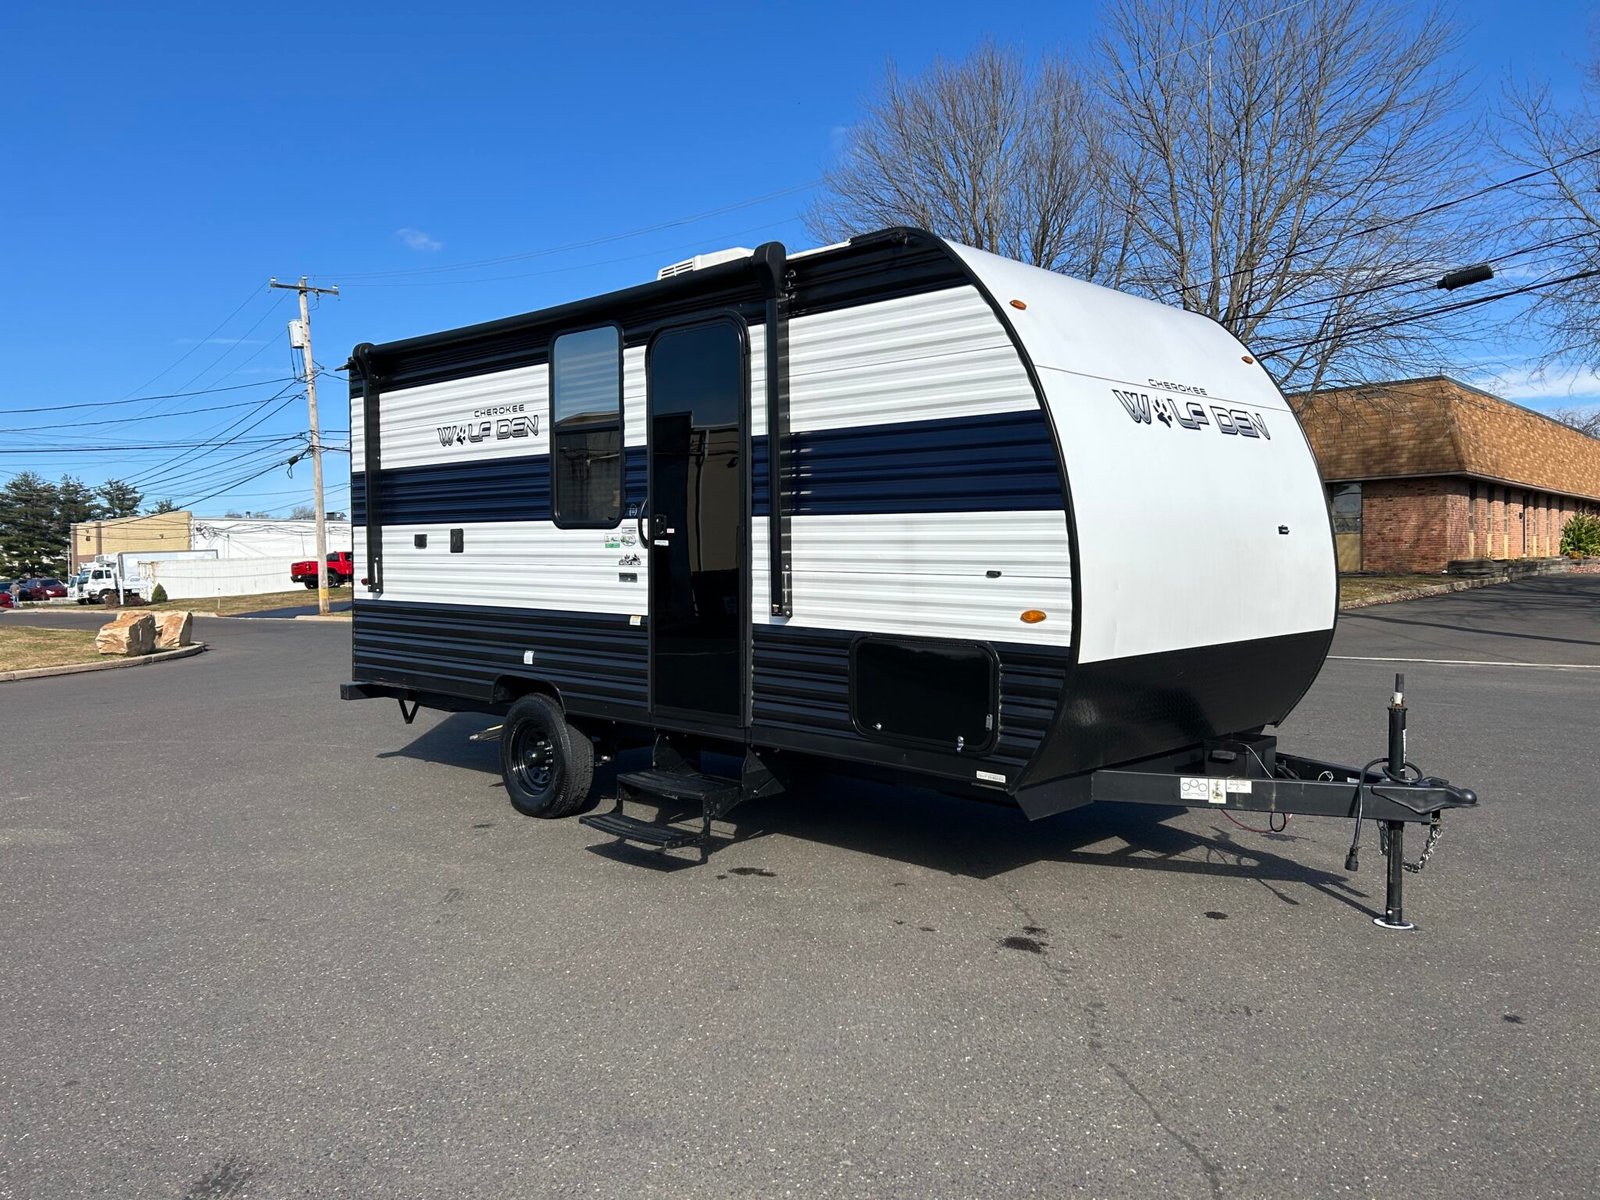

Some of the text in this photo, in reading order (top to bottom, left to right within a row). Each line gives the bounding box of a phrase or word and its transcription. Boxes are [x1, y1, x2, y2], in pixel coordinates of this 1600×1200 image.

[1148, 379, 1208, 395] CHEROKEE
[474, 404, 524, 417] CHEROKEE
[496, 415, 539, 440] DEN
[1209, 405, 1271, 440] DEN
